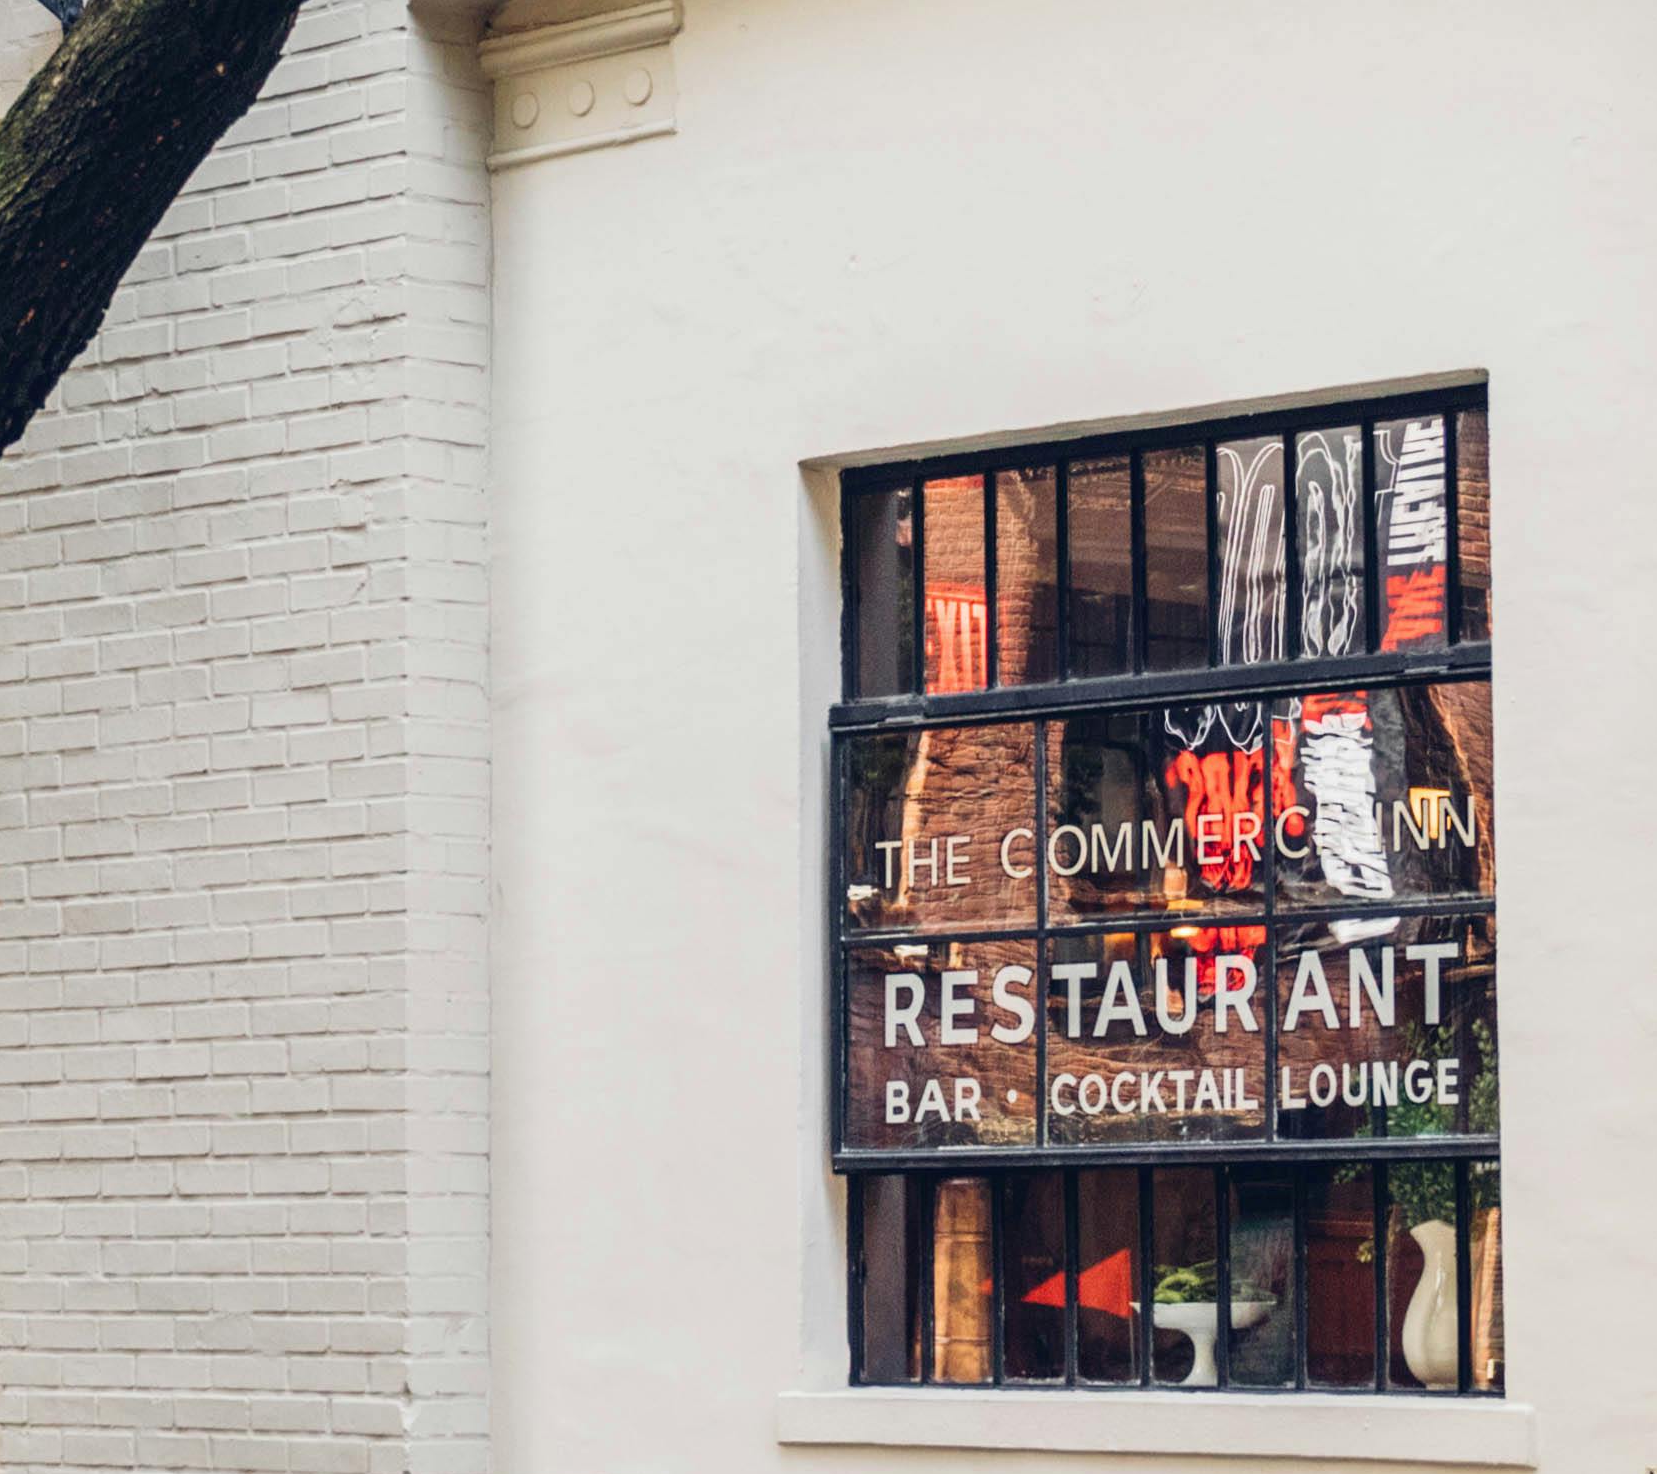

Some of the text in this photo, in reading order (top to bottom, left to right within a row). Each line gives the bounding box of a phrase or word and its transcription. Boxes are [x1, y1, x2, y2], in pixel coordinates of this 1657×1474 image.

[875, 835, 972, 889] THE
[1000, 804, 1325, 879] COMMERC
[885, 942, 1459, 1047] RESTAURANT
[885, 1058, 1460, 1124] BAR COCKTAIL LOUNGE
